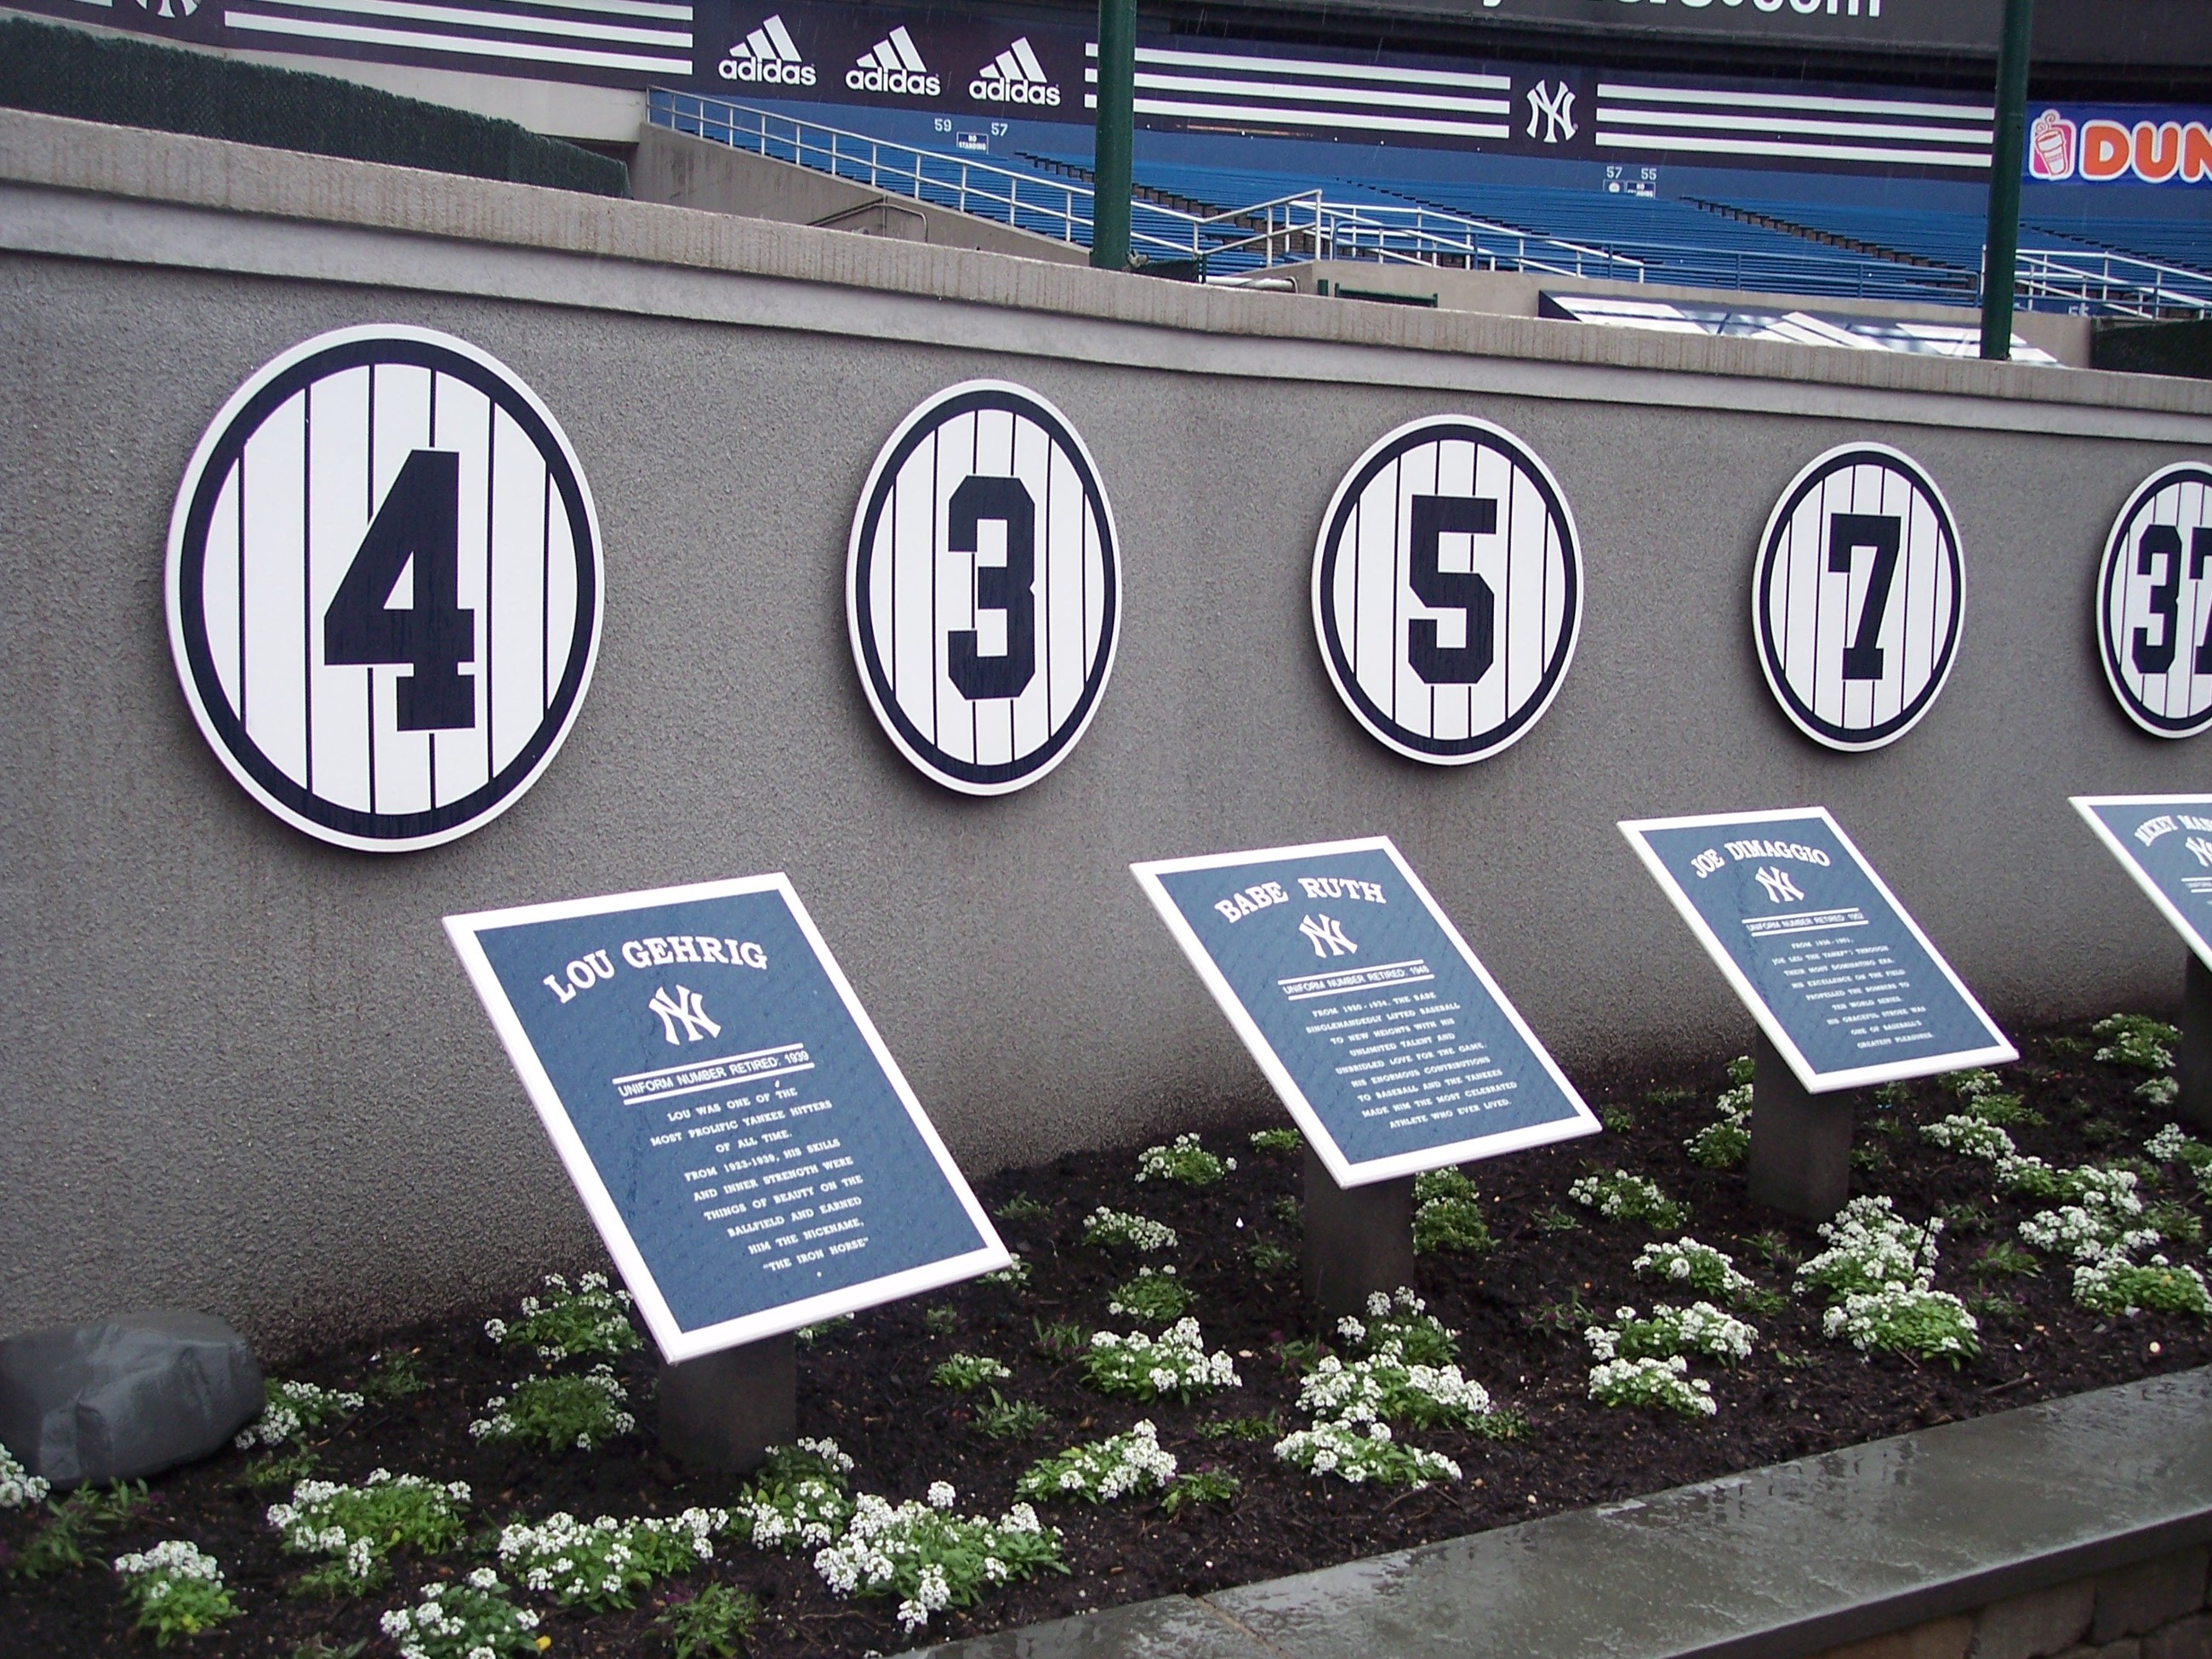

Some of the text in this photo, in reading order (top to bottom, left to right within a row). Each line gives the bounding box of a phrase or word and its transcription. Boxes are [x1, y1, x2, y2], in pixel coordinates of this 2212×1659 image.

[718, 56, 817, 87] adidas
[846, 67, 941, 97] adidas
[968, 77, 1061, 107] adidas
[934, 118, 952, 133] 59
[991, 123, 1008, 136] 57
[1606, 165, 1623, 179] 57
[1640, 168, 1657, 180] 55
[323, 448, 476, 733] 4
[947, 475, 1035, 700] 3
[1408, 494, 1498, 685] 5
[1827, 513, 1901, 681] 7
[2131, 524, 2212, 675] 37
[1691, 840, 1831, 879] JOE DIMAGGIO
[1214, 877, 1387, 924] BABE RUTH
[544, 936, 767, 1004] LOU GEHRIG
[1283, 981, 1325, 995] UNIFORM
[1327, 975, 1365, 987] NUMBER
[1410, 965, 1430, 974] 1948
[1306, 1002, 1461, 1034] SINGLEHANDEDLY LIFTED BASEBALL
[1312, 1007, 1339, 1018] FROM
[1393, 995, 1411, 1005] THE
[1413, 992, 1436, 1001] BABE
[1330, 1018, 1455, 1045] TO NEW HEIGHTS WITH HIS
[1349, 1033, 1456, 1057] UNLIMITED TALENT AND
[618, 1050, 809, 1097] UNIFORM NUMBER RETIRED: 1939
[1335, 1060, 1385, 1075] UNBRIDLED
[1389, 1055, 1413, 1065] LOVE
[1416, 1052, 1434, 1060] FOR
[1437, 1047, 1456, 1057] THE
[1351, 1056, 1491, 1088] HIS ENORMOUS CONTRIBUTIONS
[1357, 1069, 1503, 1103] TO BASEBALL AND THE YANKEES
[1361, 1081, 1518, 1118] MADE HIM THE MOST CELEBRATED
[667, 1087, 798, 1122] LOU WAS ONE OF THE
[1389, 1115, 1428, 1129] ATHLETE
[1430, 1110, 1453, 1120] WHO
[1457, 1104, 1480, 1115] EVER
[650, 1100, 833, 1147] MOST PROLIFIC YANKEE HITTERS
[715, 1130, 792, 1153] OF ALL TIME.
[684, 1166, 718, 1182] FROM
[783, 1147, 802, 1159] HIS
[807, 1138, 841, 1154] SKILLS
[693, 1156, 854, 1202] AND INNER STRENGTH WERE
[704, 1175, 864, 1221] THINGS OF BEAUTY ON THE
[727, 1196, 862, 1238] BALLFIELD AND EARNED
[748, 1241, 772, 1255] HIM
[775, 1234, 799, 1247] THE
[796, 1249, 824, 1264] IRON
